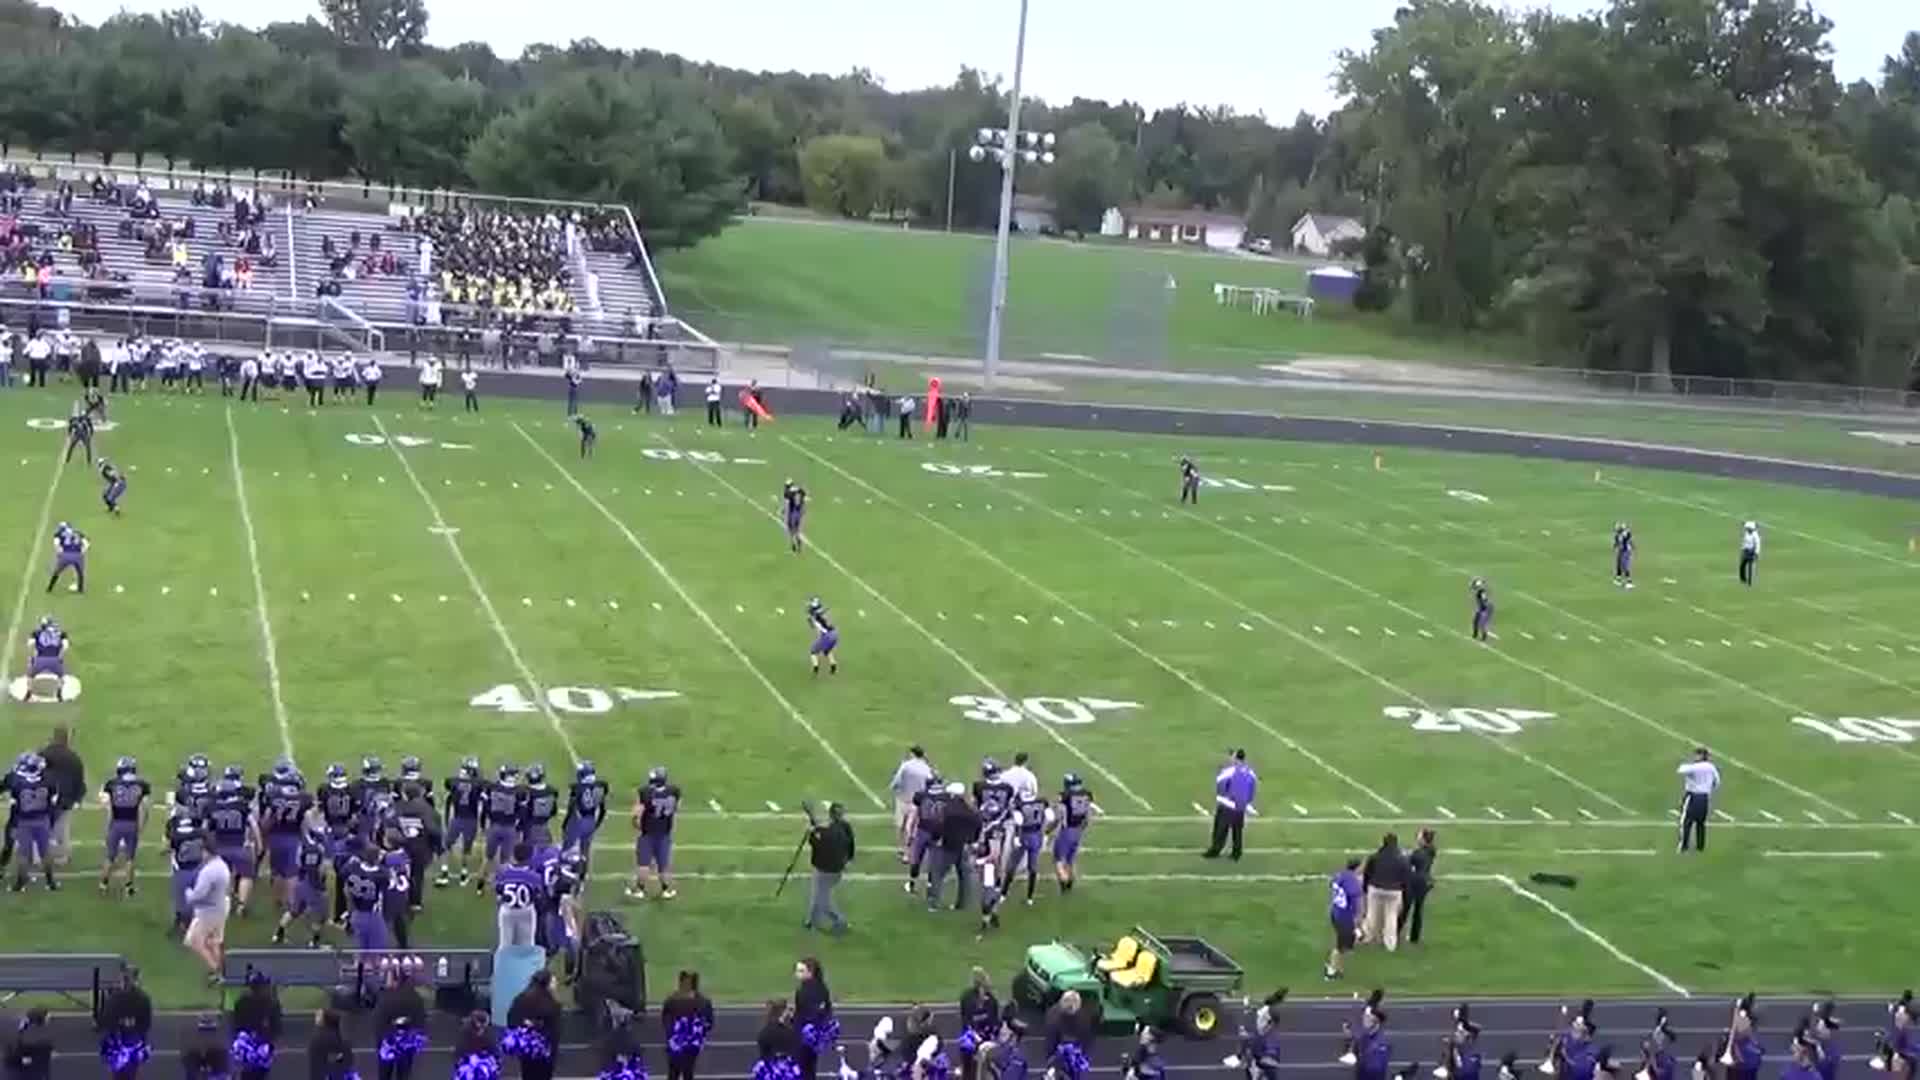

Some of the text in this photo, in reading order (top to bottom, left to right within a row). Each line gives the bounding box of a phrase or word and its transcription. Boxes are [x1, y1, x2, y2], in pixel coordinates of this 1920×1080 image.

[469, 684, 613, 712] 40
[949, 695, 1096, 723] 30
[1383, 706, 1522, 733] 20
[1791, 716, 1914, 743] 10
[503, 884, 530, 907] 50
